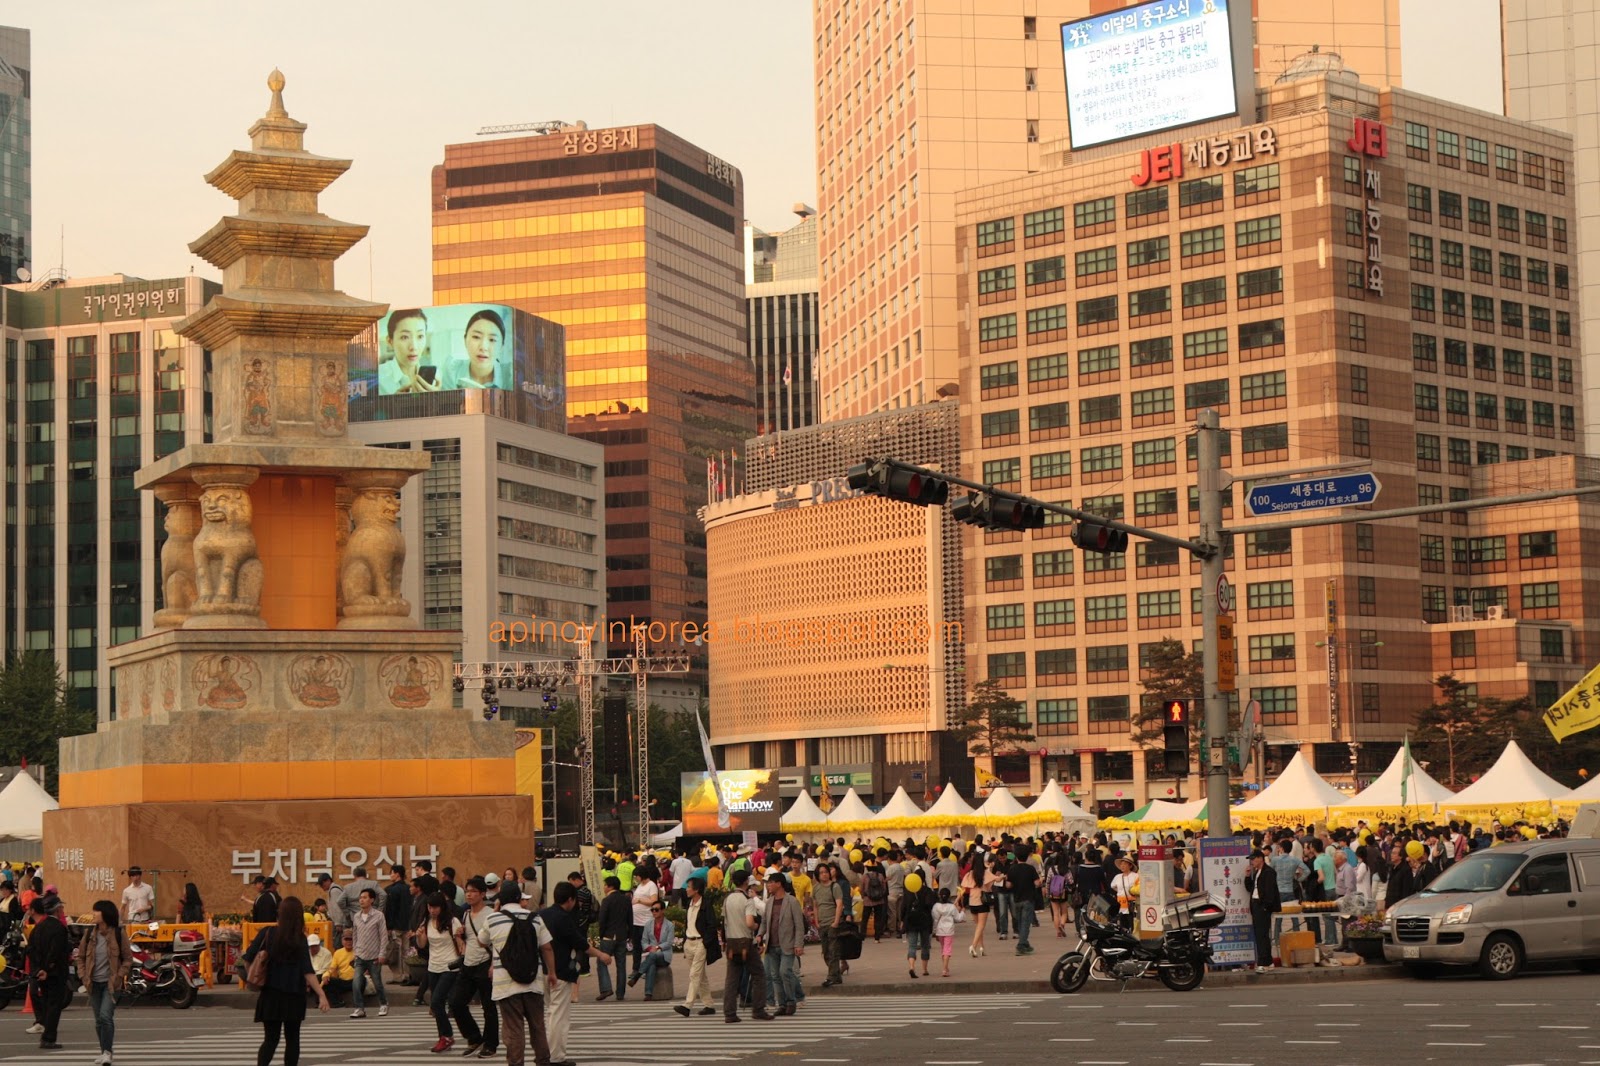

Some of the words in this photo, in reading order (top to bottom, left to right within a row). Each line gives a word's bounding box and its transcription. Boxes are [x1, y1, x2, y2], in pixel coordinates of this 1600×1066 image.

[1102, 12, 1138, 36] 이달의
[1141, 0, 1190, 28] 중구소식
[1157, 28, 1175, 48] 중구
[562, 126, 639, 156] 삼성화재
[1188, 126, 1277, 168] 재능교육
[1347, 117, 1388, 158] JEI
[708, 154, 737, 188] 삼성화재
[1130, 142, 1182, 186] JEI
[1366, 168, 1384, 297] 재능교육
[84, 288, 179, 318] 국가인권위원회
[1252, 494, 1270, 506] 100
[1290, 482, 1337, 496] 세종대로
[1358, 482, 1372, 494] 96
[722, 778, 750, 788] Over
[722, 788, 742, 800] the
[724, 798, 774, 810] Rainbow
[56, 848, 68, 870] 마음에
[69, 848, 84, 871] 평화를
[230, 844, 440, 885] 부처님오신날
[100, 867, 114, 891] 행복을
